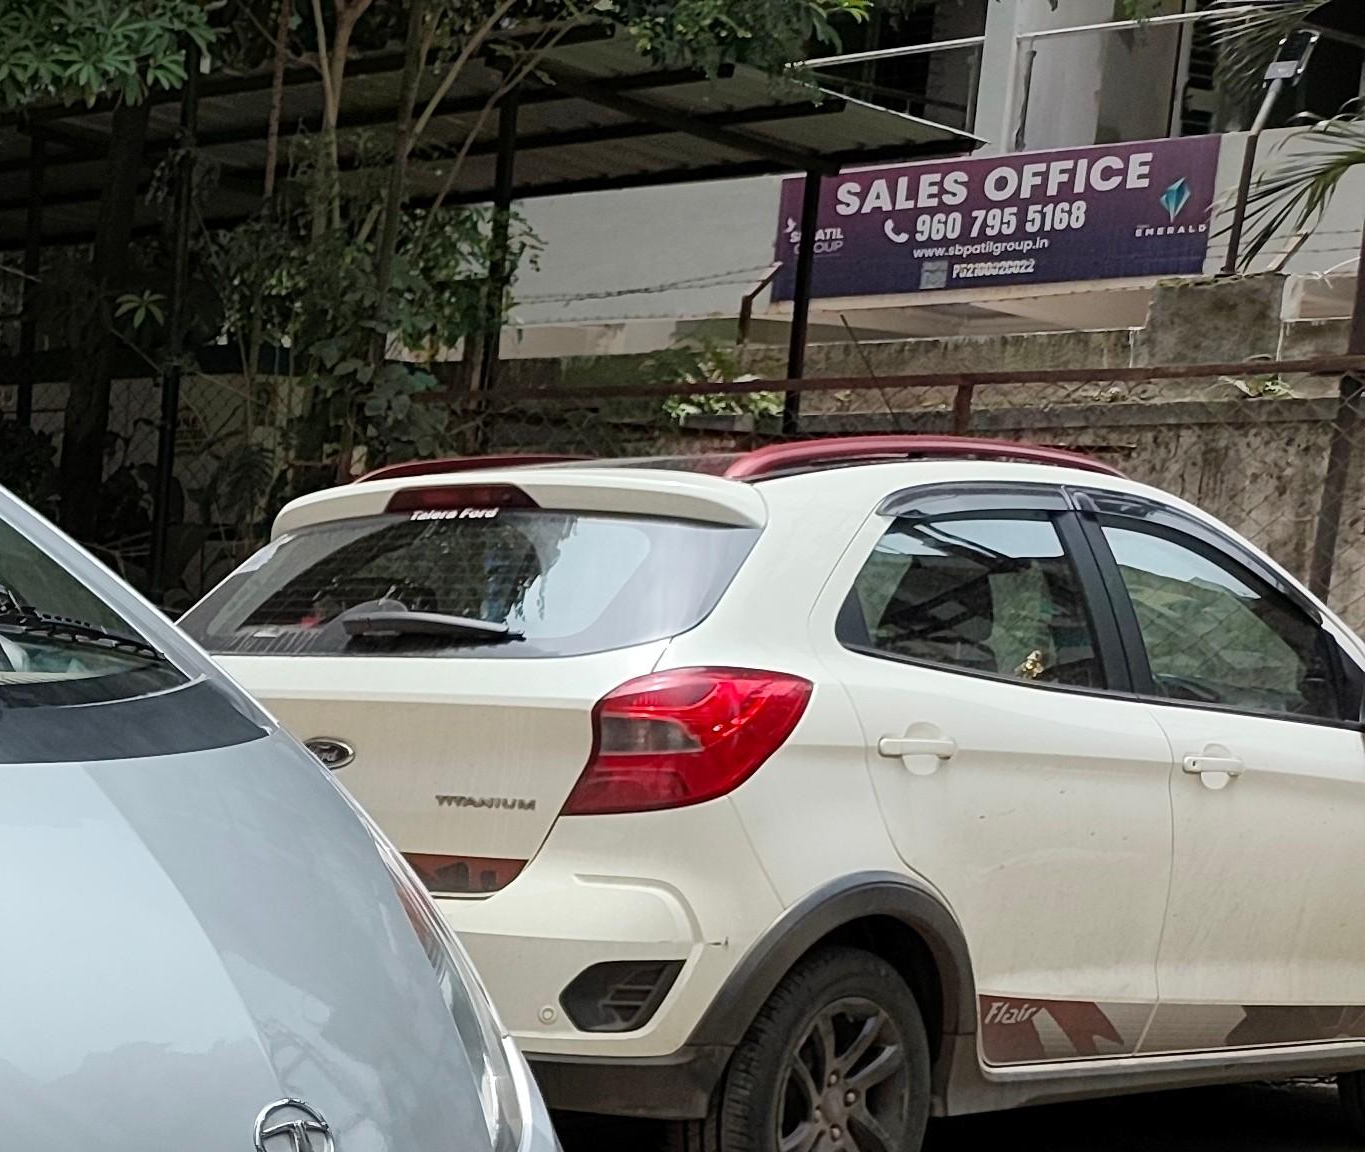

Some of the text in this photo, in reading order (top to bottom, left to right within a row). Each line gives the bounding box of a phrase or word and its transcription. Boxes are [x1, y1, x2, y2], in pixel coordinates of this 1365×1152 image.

[835, 152, 1153, 216] SALES OFFICE
[915, 200, 1087, 241] 960 795 5168
[1135, 223, 1207, 237] EMERALD
[912, 236, 1049, 258] www.sbpatilgroup.in
[459, 507, 499, 519] Ford
[435, 795, 536, 811] TITANIUM
[984, 1001, 1037, 1024] Flair
